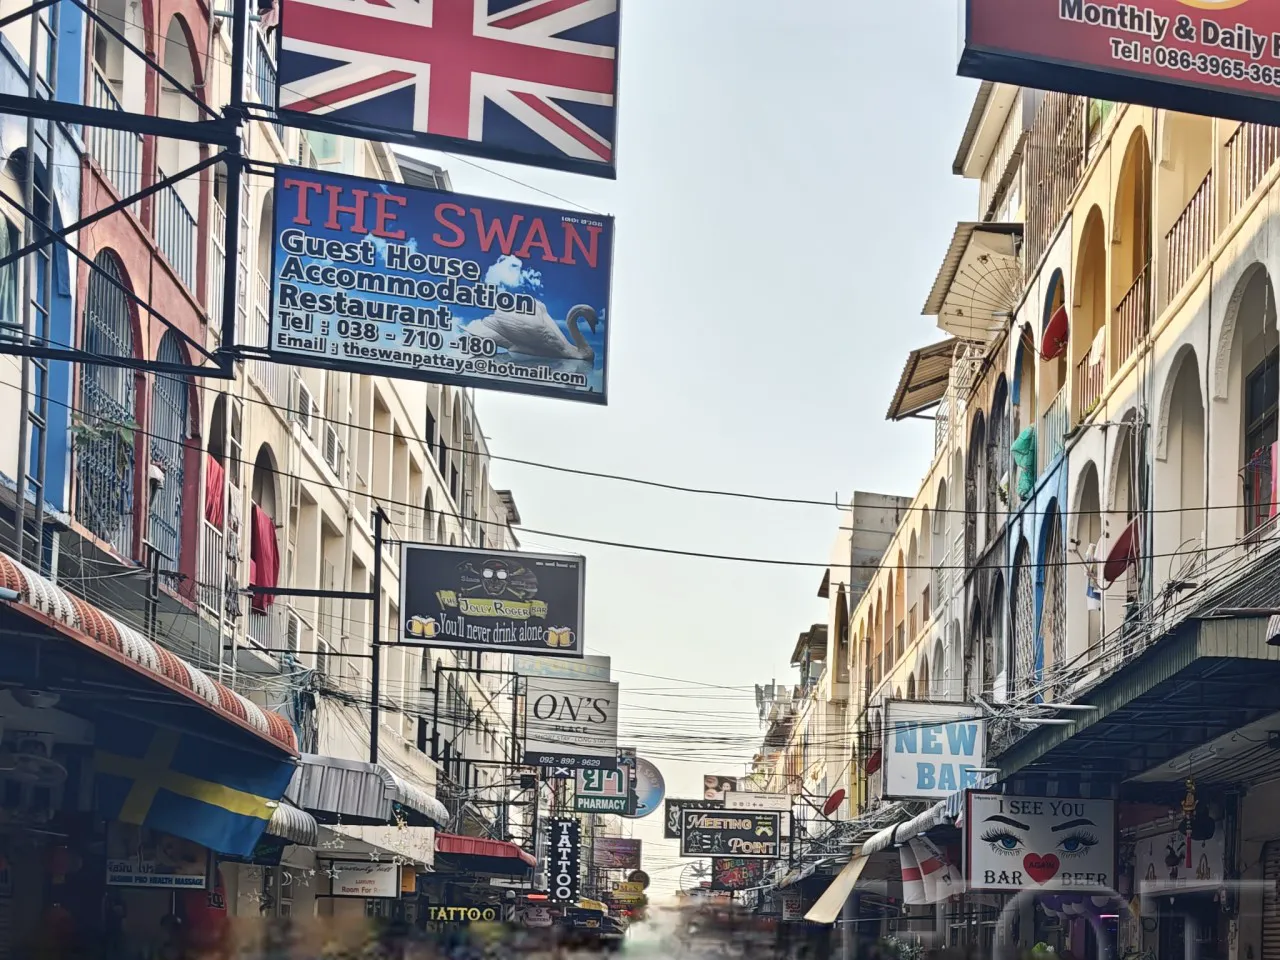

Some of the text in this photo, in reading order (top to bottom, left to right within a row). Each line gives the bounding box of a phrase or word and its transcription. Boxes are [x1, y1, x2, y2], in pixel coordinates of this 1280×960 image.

[1059, 0, 1168, 41] Monthly
[1174, 16, 1196, 41] &
[1201, 20, 1266, 59] Daily
[1109, 38, 1139, 61] Tel
[284, 178, 602, 268] THE SWAN
[280, 229, 480, 279] Guest House
[280, 256, 536, 316] Accommodation
[279, 284, 453, 331] Restaurant
[277, 311, 313, 332] Tel
[337, 319, 378, 342] 038
[402, 328, 443, 350] 710
[449, 337, 497, 357] -180
[277, 333, 326, 352] Email
[343, 341, 588, 387] theswanpattaya@hotmail.com
[460, 599, 491, 612] JOLLY
[494, 600, 529, 617] ROGER
[531, 605, 547, 615] BAR
[440, 612, 542, 643] You'll never drink alone
[533, 693, 611, 724] ON'S
[895, 721, 977, 756] NEW
[539, 756, 554, 764] 092
[560, 757, 575, 765] 899
[582, 758, 600, 766] 9629
[917, 762, 977, 790] BAR
[578, 797, 626, 810] PHARMACY
[999, 799, 1084, 817] I SEE YOU
[556, 821, 572, 899] TATTOO
[149, 876, 173, 885] HEALTH
[175, 878, 204, 886] MASSAGE
[984, 870, 1107, 886] BAR BEER
[428, 906, 495, 921] TATTOO
